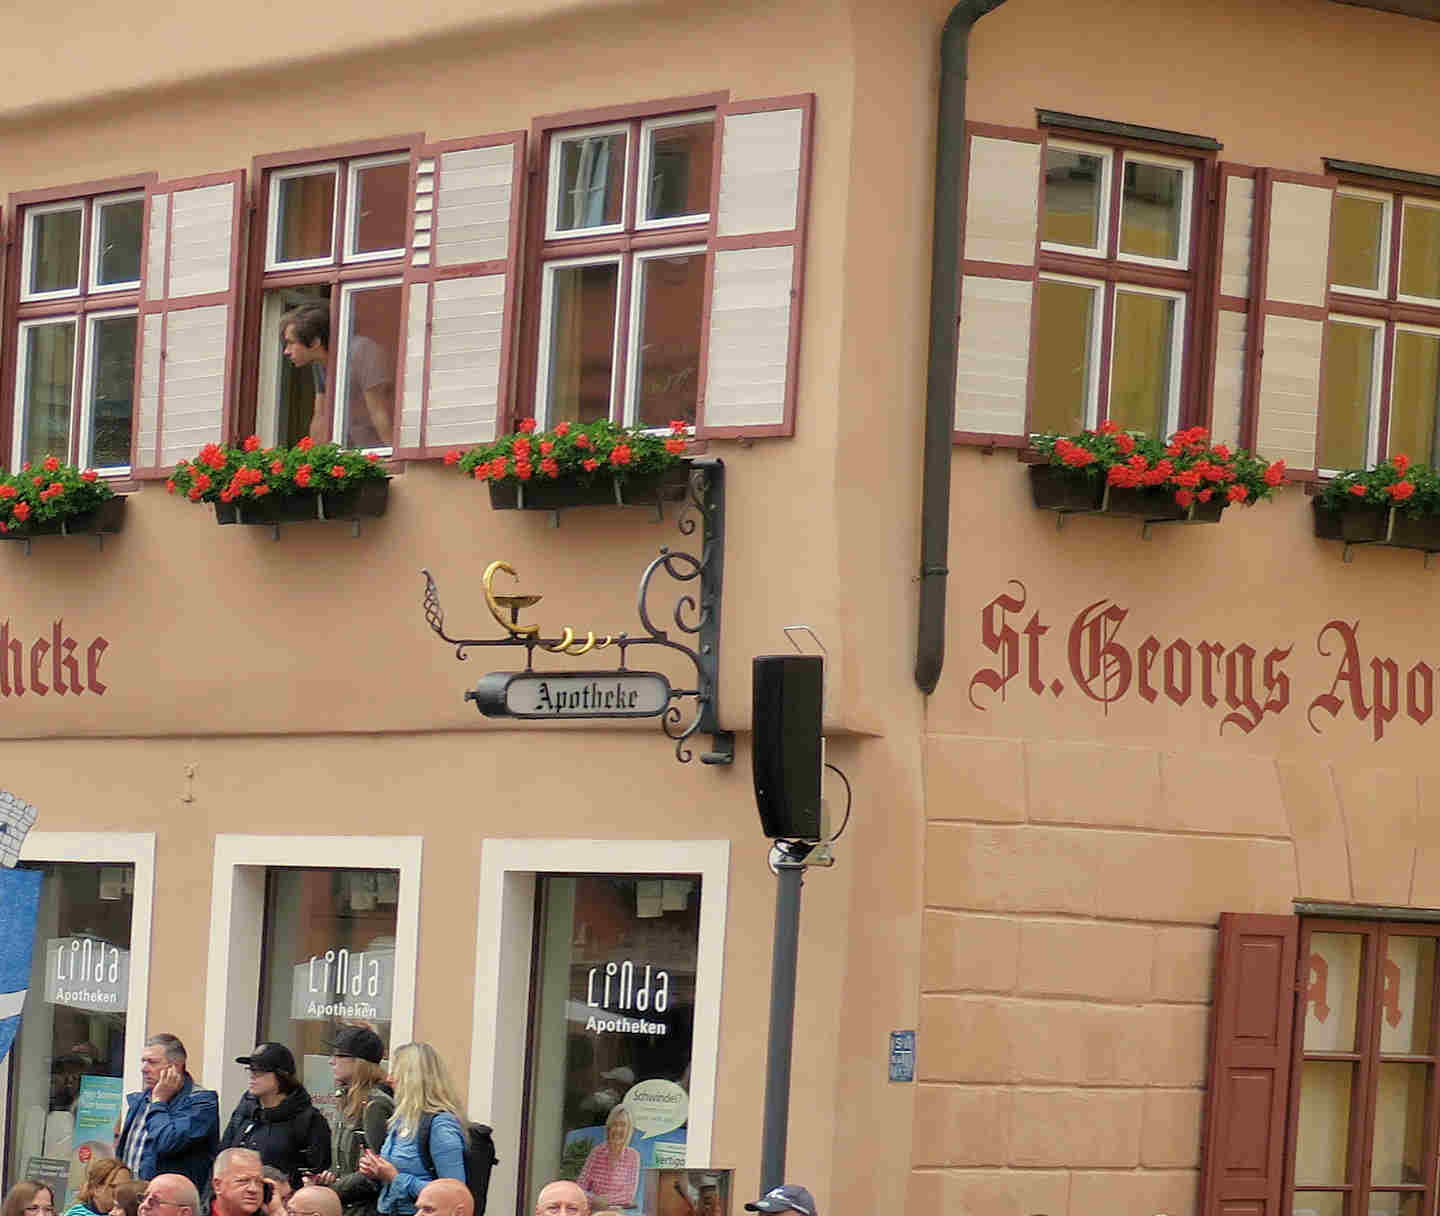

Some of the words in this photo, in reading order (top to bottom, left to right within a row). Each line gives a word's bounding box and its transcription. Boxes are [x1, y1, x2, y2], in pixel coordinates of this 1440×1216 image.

[1307, 618, 1440, 742] Apo
[534, 682, 640, 713] Apotheke
[56, 987, 117, 1004] Apotheken
[307, 1001, 377, 1018] Apotheken
[585, 1015, 666, 1036] Apotheken
